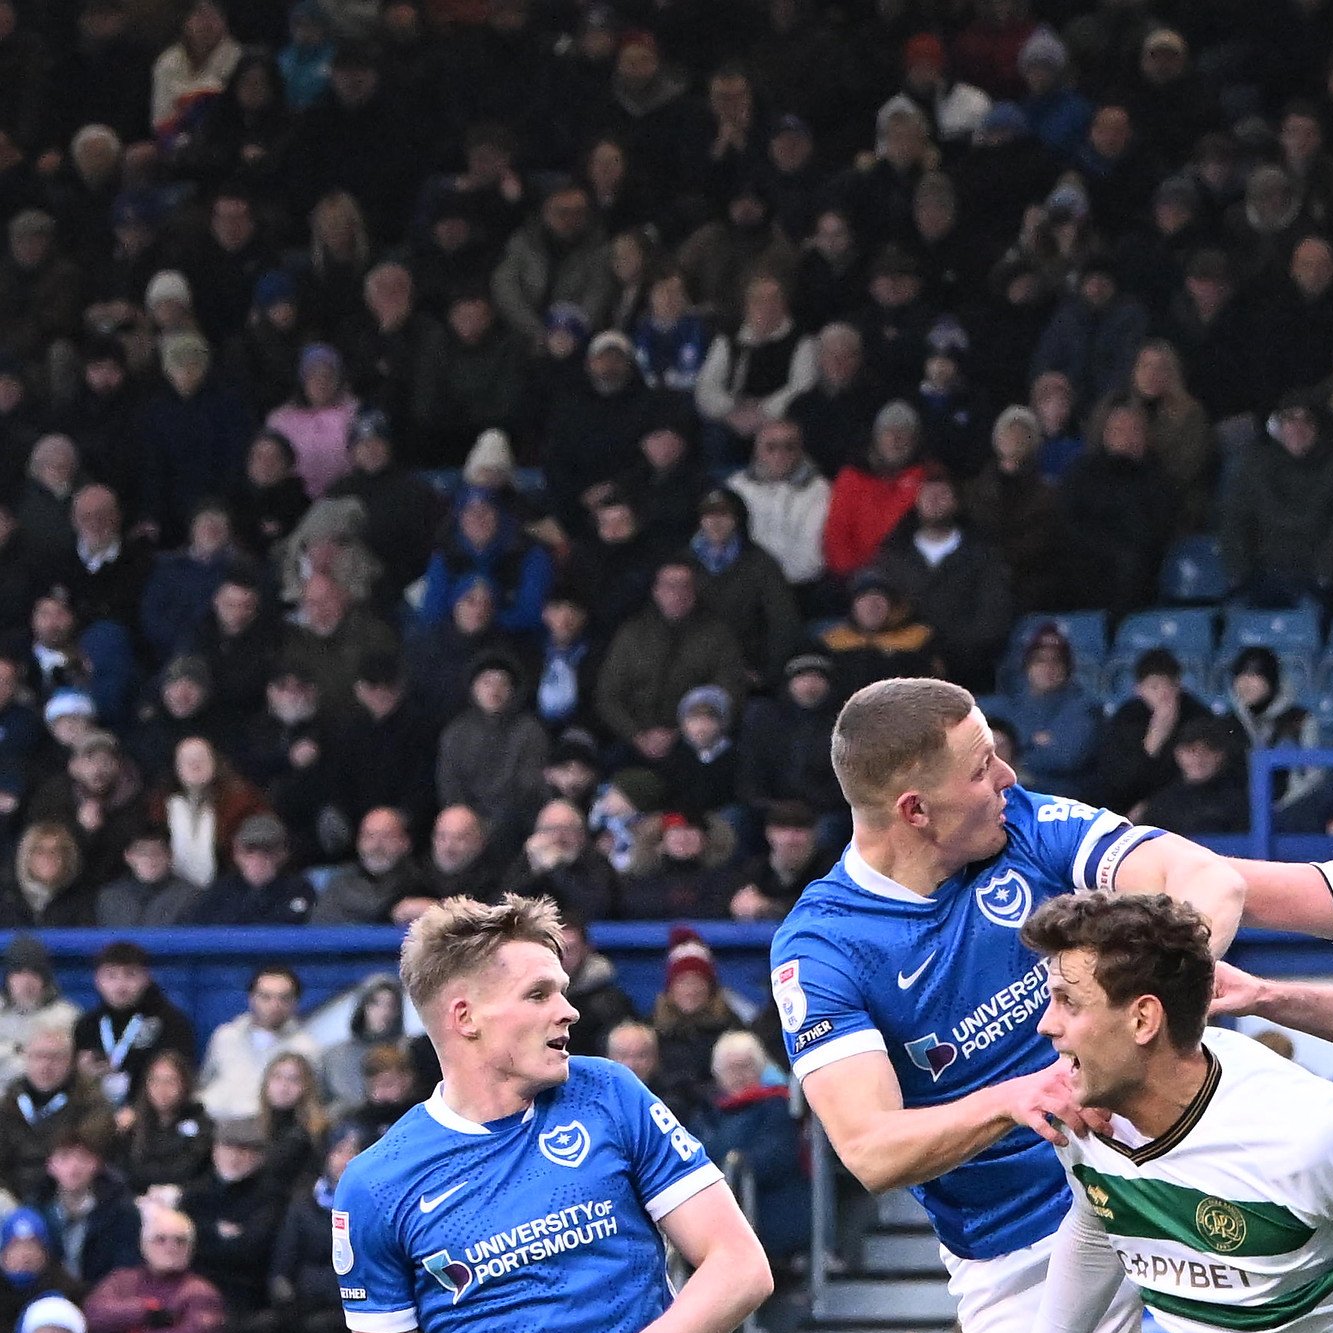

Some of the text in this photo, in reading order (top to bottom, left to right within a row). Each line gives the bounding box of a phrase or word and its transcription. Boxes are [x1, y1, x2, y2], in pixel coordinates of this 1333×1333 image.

[952, 957, 1050, 1042] UNIVERSIT
[961, 982, 1051, 1060] PORTSMO
[465, 1200, 614, 1264] UNIVERSITY OF
[474, 1217, 618, 1284] PORTSMOUTH
